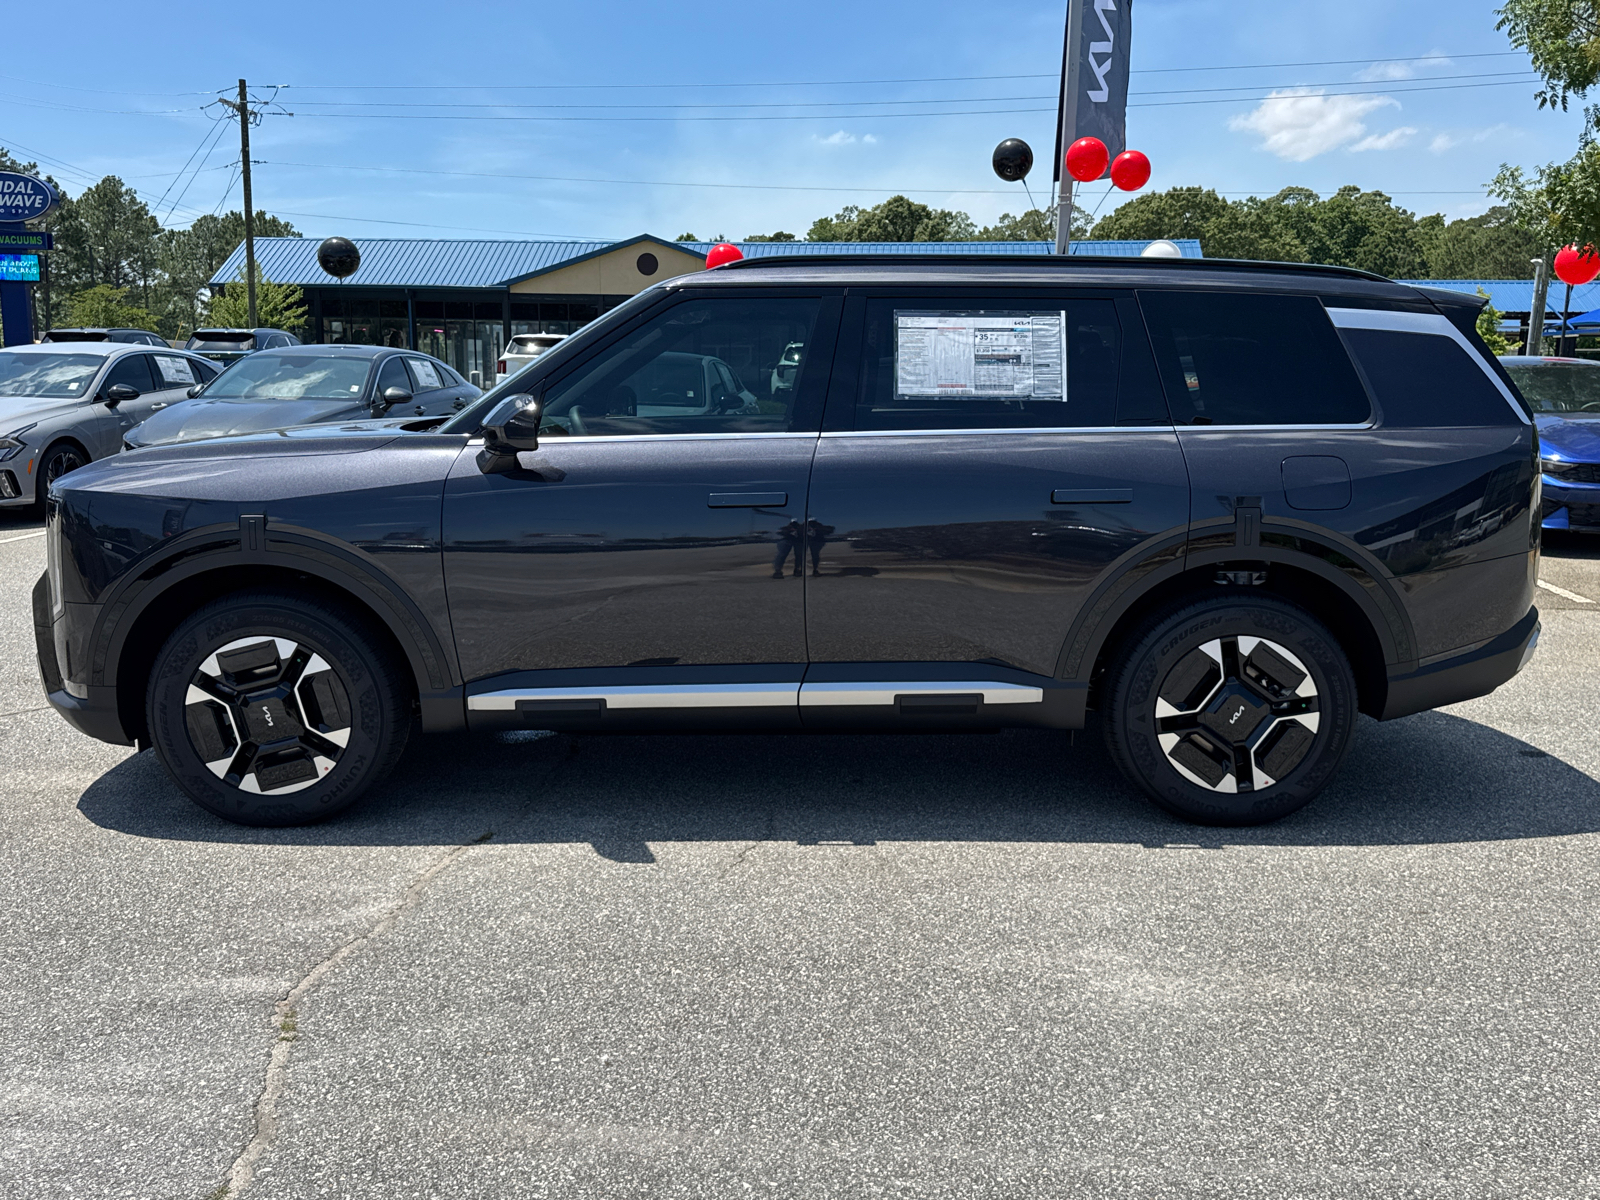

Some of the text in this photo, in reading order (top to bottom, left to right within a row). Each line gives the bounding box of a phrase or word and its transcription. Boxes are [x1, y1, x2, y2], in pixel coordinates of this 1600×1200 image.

[1087, 0, 1117, 103] KIA
[0, 193, 43, 207] WAVE
[0, 235, 43, 244] VACUUMS
[979, 333, 989, 341] 35
[1160, 615, 1223, 657] CRUGEN
[262, 705, 274, 727] KIA
[1229, 705, 1245, 725] KIA
[159, 701, 185, 769] CRUGEN
[319, 754, 368, 804] KUMHO
